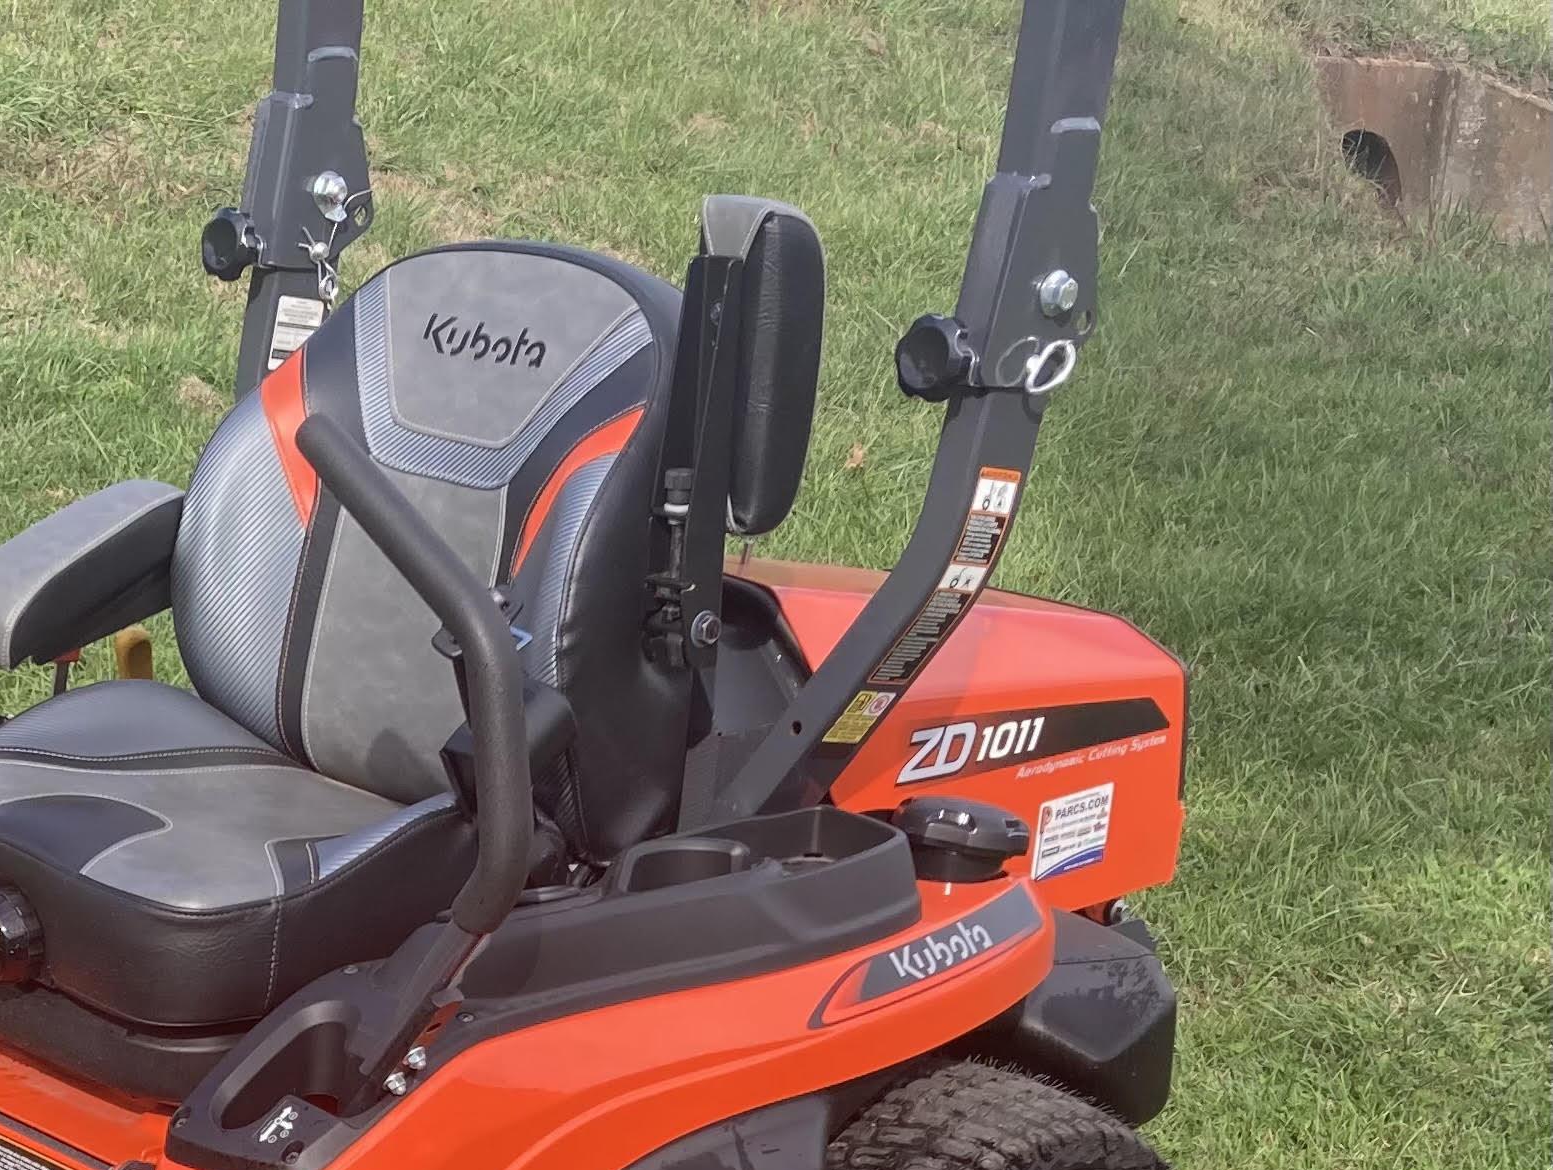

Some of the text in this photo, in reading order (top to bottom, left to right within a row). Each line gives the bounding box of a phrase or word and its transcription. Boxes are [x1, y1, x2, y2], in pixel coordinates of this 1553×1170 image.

[423, 313, 547, 369] Kubota
[1016, 735, 1167, 779] Aerodynamic Cutting System
[1055, 795, 1109, 820] PARCS.COM
[889, 921, 994, 979] Kubota
